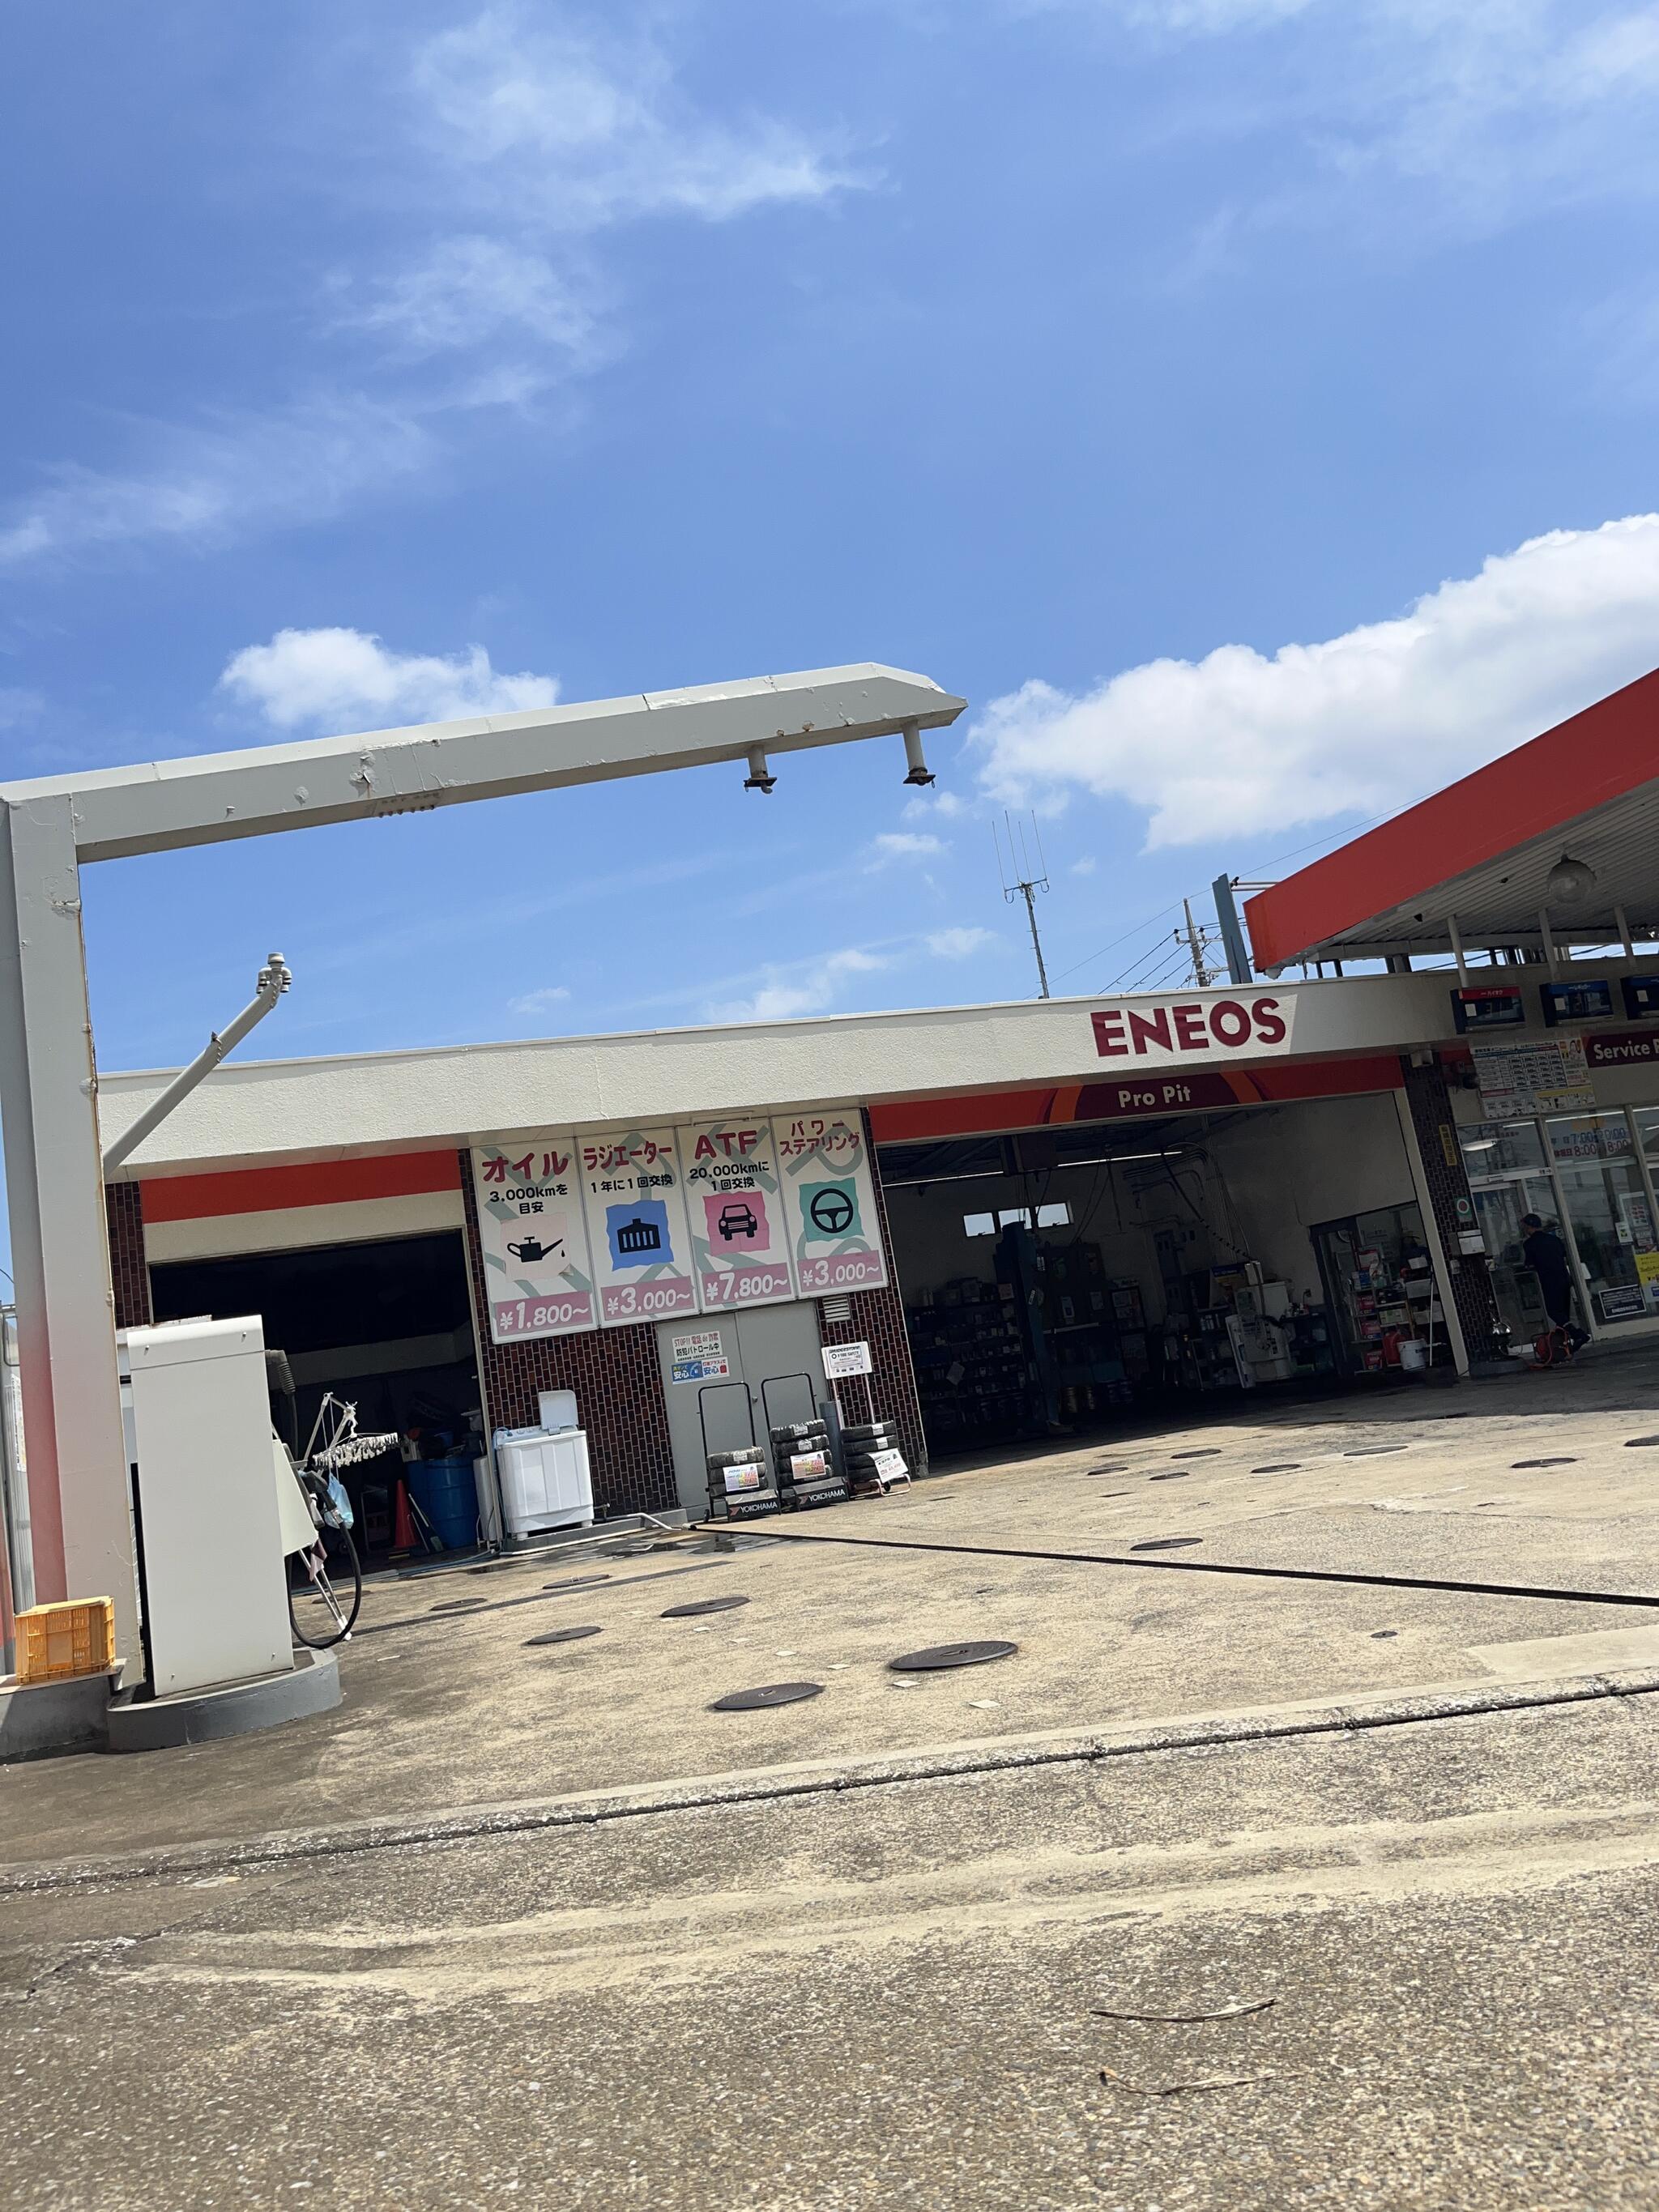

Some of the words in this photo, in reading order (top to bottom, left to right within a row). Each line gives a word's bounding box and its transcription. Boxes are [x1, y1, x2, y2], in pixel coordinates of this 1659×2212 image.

[1090, 997, 1286, 1057] ENEOS
[1593, 1040, 1650, 1059] Service
[1118, 1089, 1155, 1108] Pro
[1162, 1084, 1191, 1103] Pit
[791, 1119, 844, 1137] パワー
[694, 1130, 757, 1160] ATF
[779, 1132, 860, 1157] ステアリング
[583, 1140, 672, 1170] ラジエーター
[482, 1151, 569, 1183] オイル
[591, 1174, 673, 1193] 1年に1回交換
[710, 1177, 755, 1191] 1回交換
[519, 1201, 544, 1214] 目安
[674, 1370, 689, 1380] 安心
[703, 1366, 719, 1375] 安心
[808, 1489, 845, 1502] YOKOHAMA
[740, 1501, 778, 1513] YOKOHAMA
